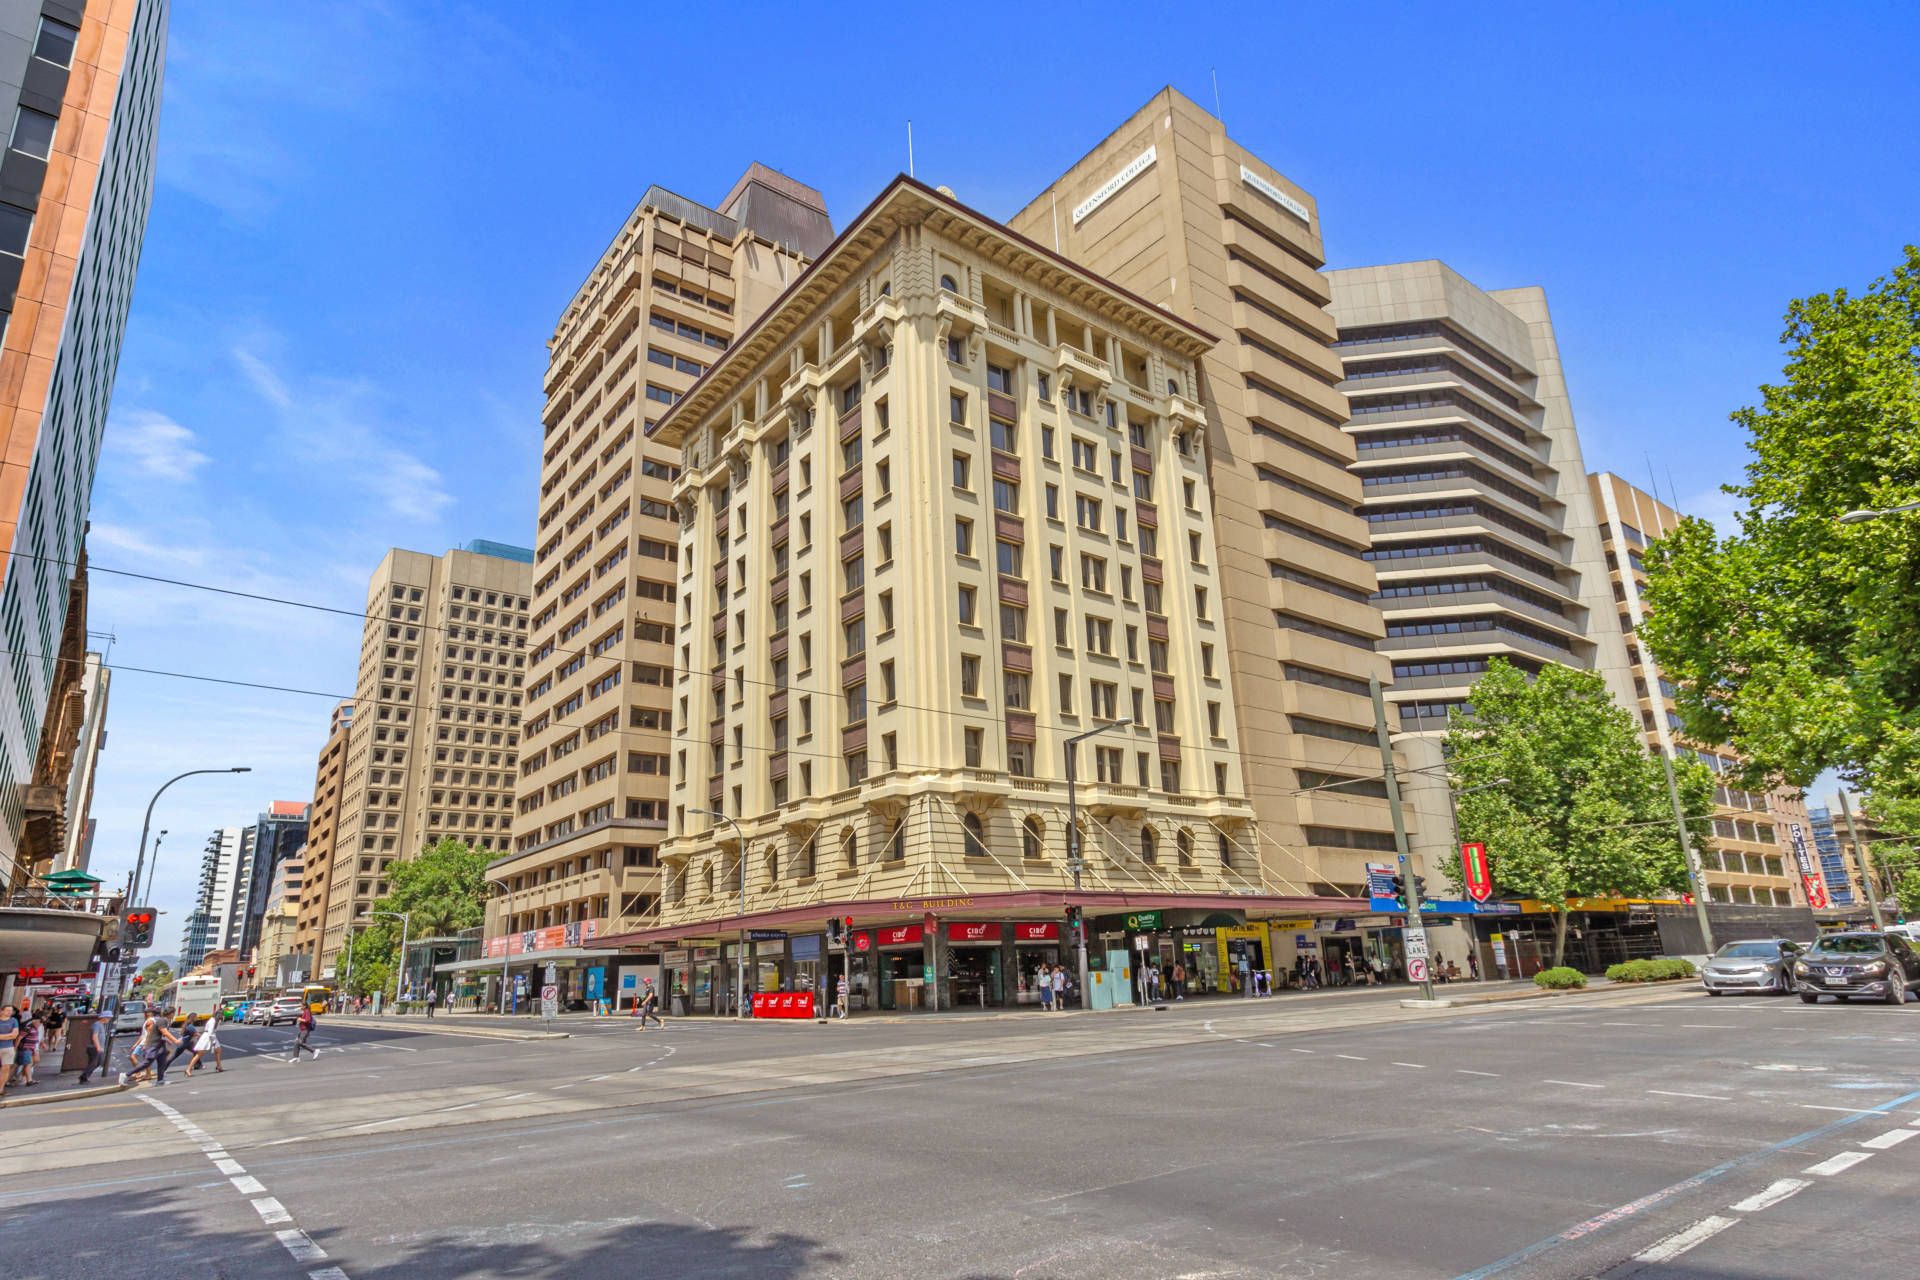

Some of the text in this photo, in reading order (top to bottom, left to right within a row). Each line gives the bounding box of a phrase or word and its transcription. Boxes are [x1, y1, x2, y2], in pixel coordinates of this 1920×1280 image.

[1075, 153, 1151, 218] QUEENSFORD COLLEGE
[892, 898, 974, 910] T&G BUILDING
[966, 926, 985, 935] CIBO
[1029, 925, 1046, 935] CIBO
[1408, 946, 1426, 955] LANE
